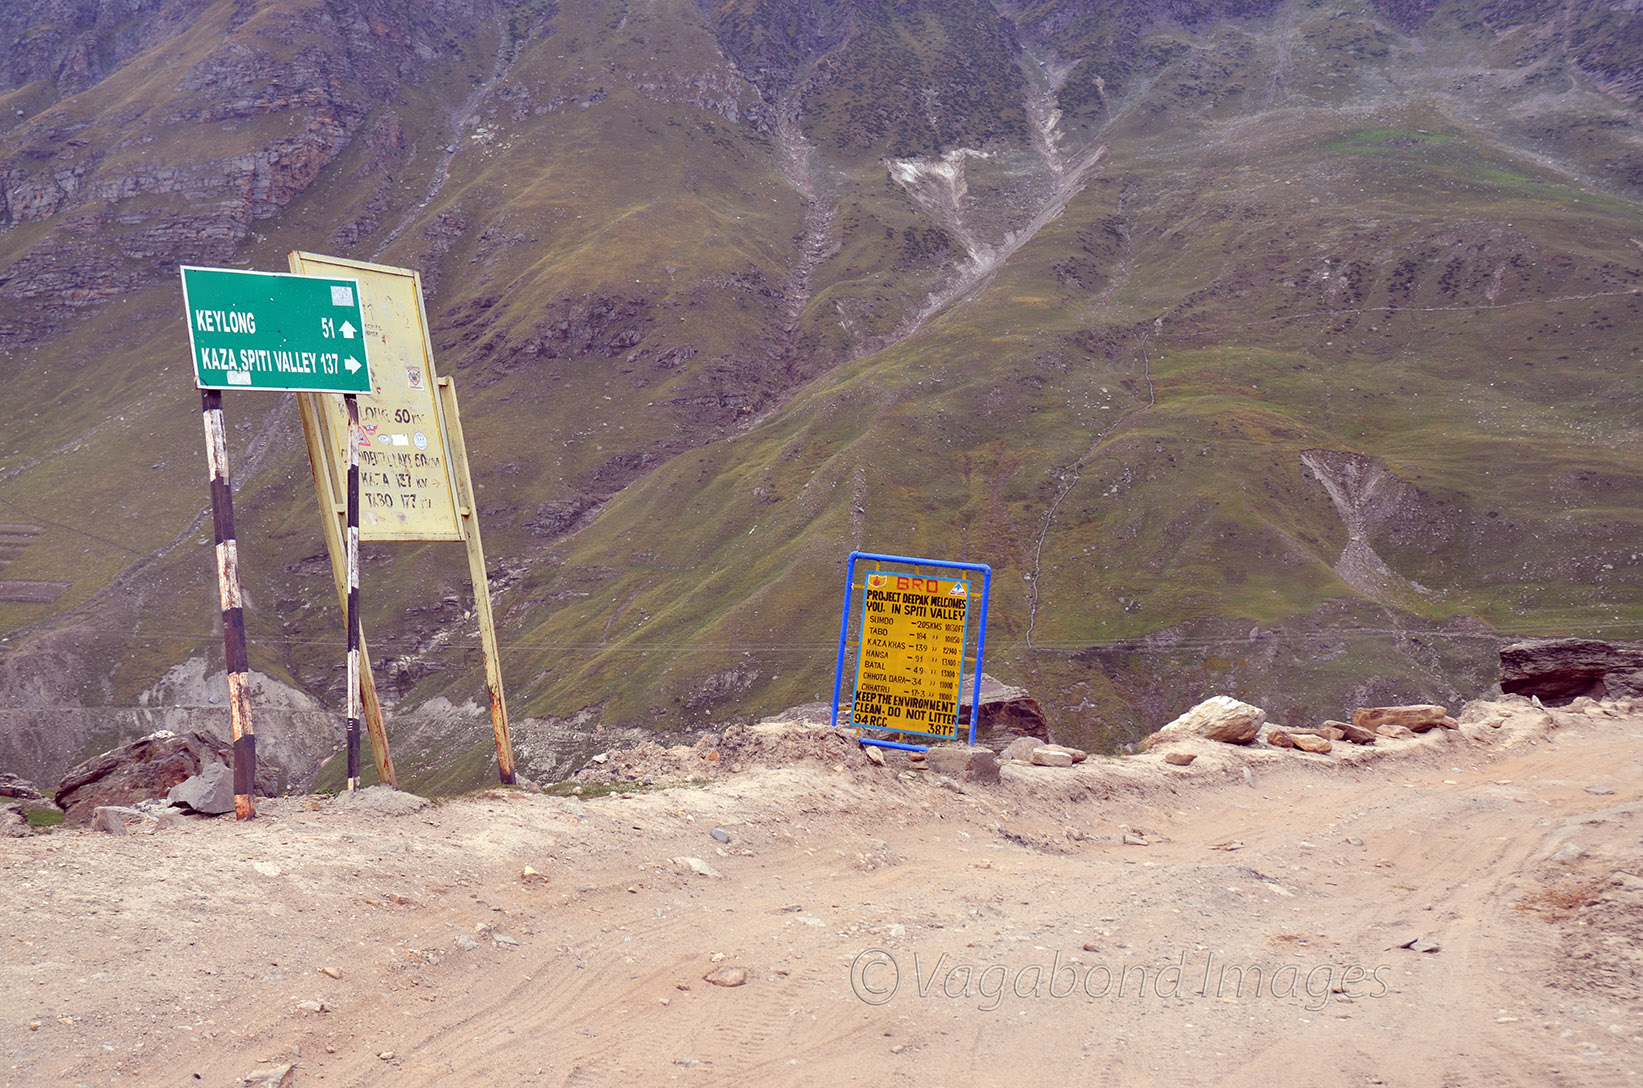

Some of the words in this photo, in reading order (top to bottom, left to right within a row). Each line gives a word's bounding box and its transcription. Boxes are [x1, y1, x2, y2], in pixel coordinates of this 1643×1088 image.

[195, 309, 257, 334] KEYLONG
[320, 317, 336, 339] 51
[272, 350, 317, 374] VALLEY
[320, 353, 339, 374] 137
[896, 576, 939, 593] BRO
[867, 590, 901, 603] PROJECT
[902, 593, 930, 606] DEEPAK
[930, 596, 967, 609] WELCOMES
[869, 615, 894, 625] SUMDO
[891, 603, 901, 615] IN
[904, 605, 927, 617] SPITI
[930, 607, 966, 621] VALLEY
[869, 627, 888, 636] TABO
[866, 649, 889, 659] HANSA
[864, 660, 886, 670] BATAL
[863, 672, 887, 682] CHHOTA
[861, 683, 890, 693] CHHATRU
[855, 691, 877, 702] KEEP
[876, 693, 892, 706] THE
[893, 696, 956, 713] ENVIRONMENT
[887, 706, 901, 718] DO
[906, 708, 927, 721] NOT
[928, 711, 958, 725] LITTER
